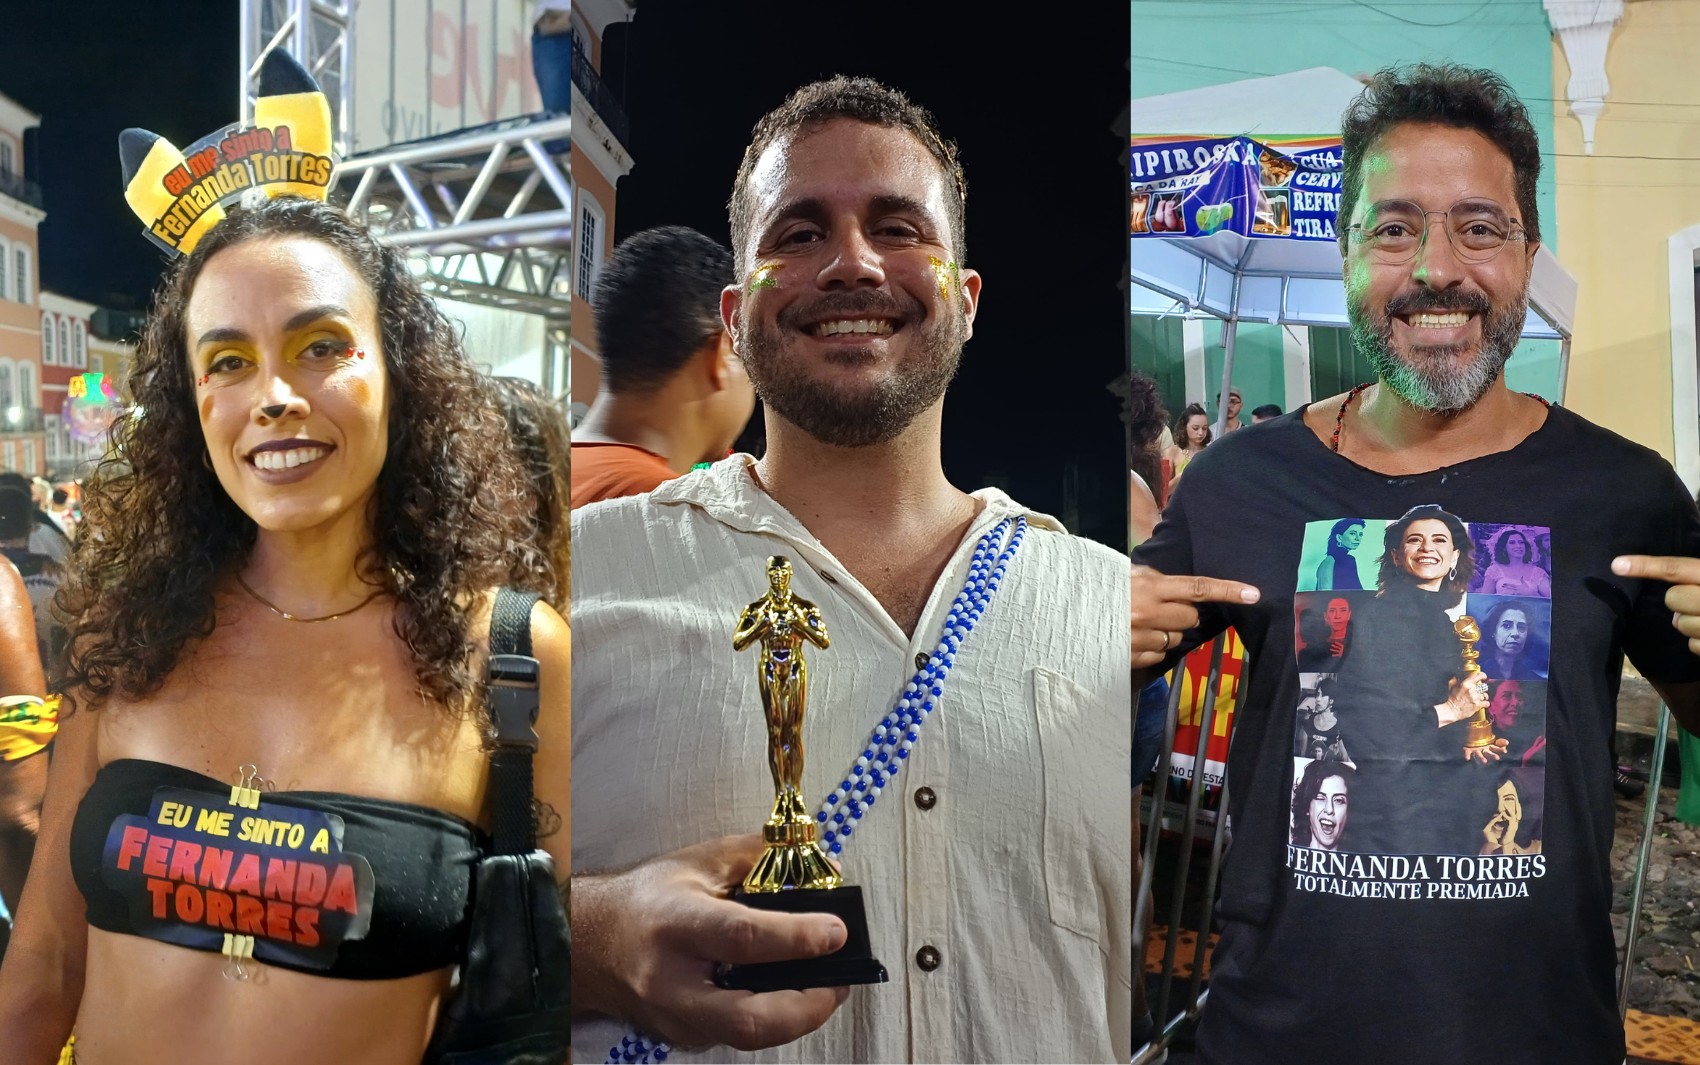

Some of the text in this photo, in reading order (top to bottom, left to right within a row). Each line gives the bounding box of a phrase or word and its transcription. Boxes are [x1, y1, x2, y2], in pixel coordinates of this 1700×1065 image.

[163, 125, 291, 195] eu me sinto a
[1131, 140, 1257, 177] IPIROSKA
[1296, 172, 1343, 188] CERV
[152, 152, 333, 247] Fernanda Torres
[1158, 179, 1176, 189] DA
[157, 801, 330, 854] EU ME SINTO A
[117, 825, 358, 915] FERNANDA
[1286, 844, 1547, 881] FERNANDA TORRES
[1294, 873, 1529, 900] TOTALMENTE PREMIADA
[147, 877, 320, 947] TORRES
